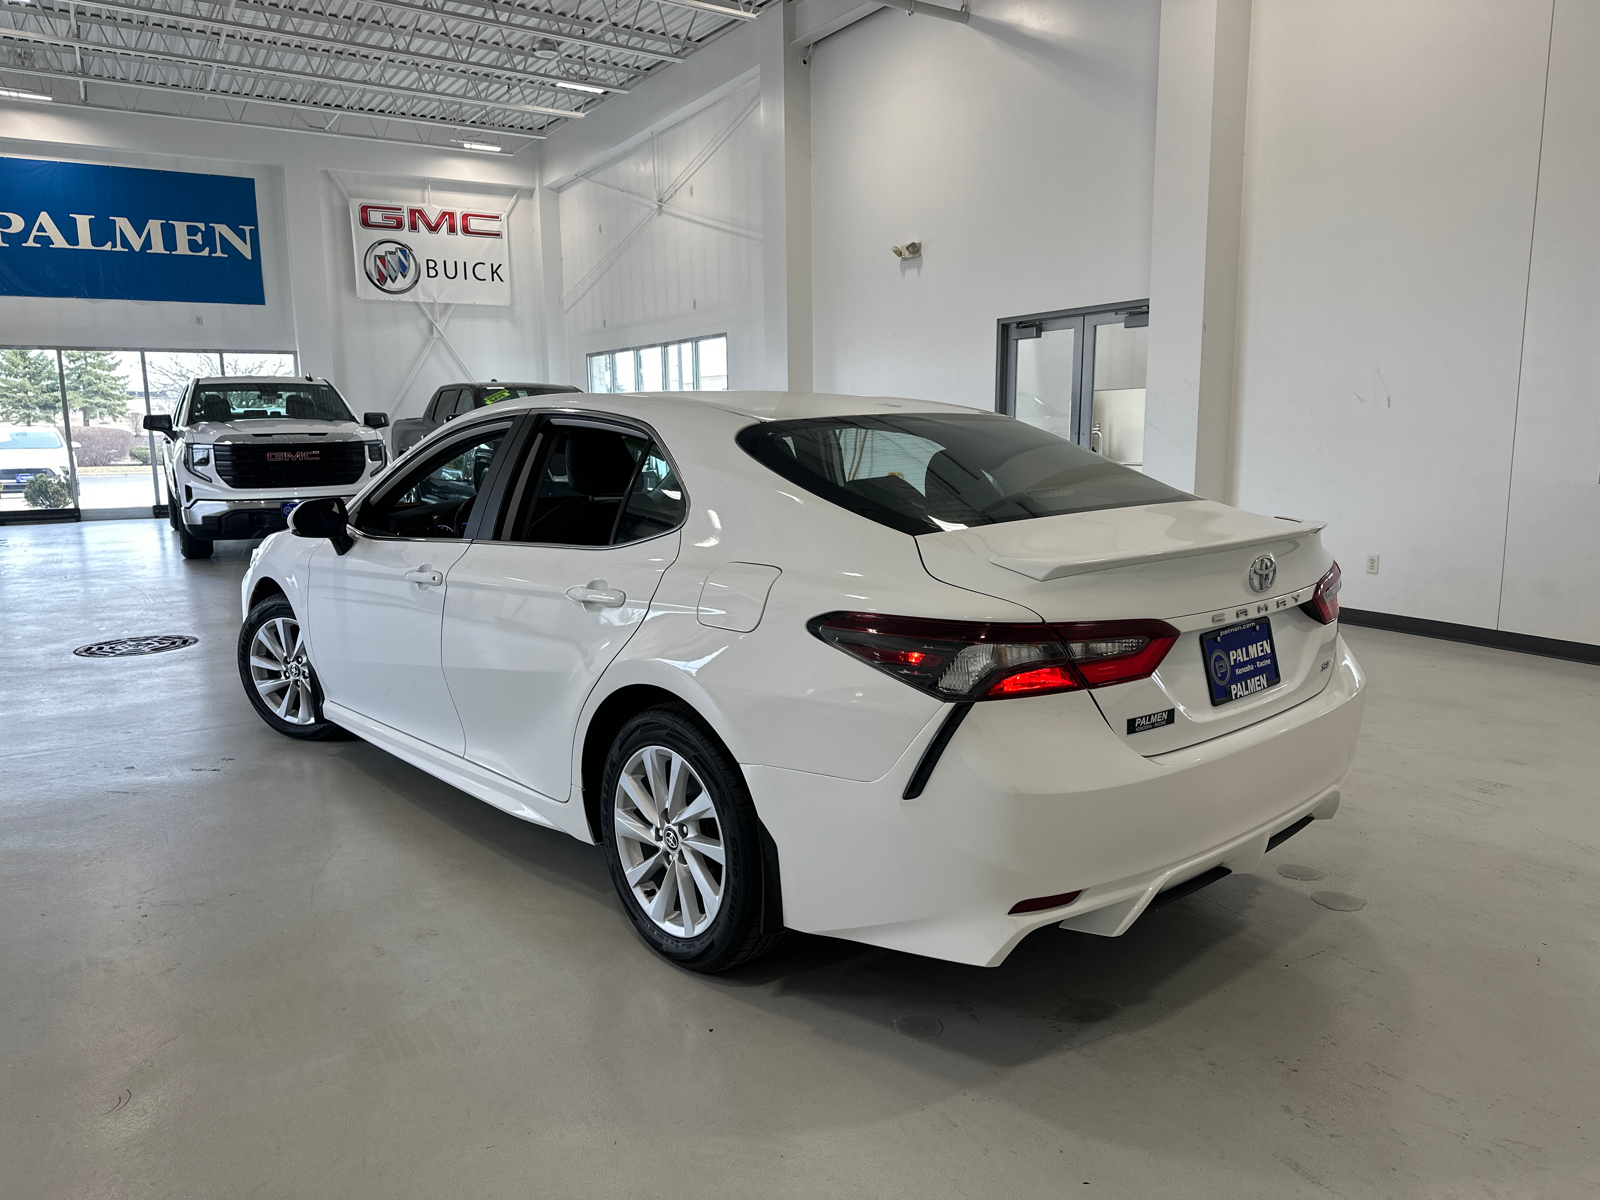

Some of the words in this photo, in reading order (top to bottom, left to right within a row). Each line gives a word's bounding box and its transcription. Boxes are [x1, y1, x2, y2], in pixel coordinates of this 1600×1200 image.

[358, 202, 503, 239] GMC
[425, 258, 504, 283] BUICK
[267, 450, 320, 462] GMC
[1211, 594, 1301, 624] CAMRY
[1219, 621, 1256, 637] palmen.com
[1229, 638, 1271, 666] PALMEN
[1235, 663, 1254, 676] Kenosha
[1256, 658, 1271, 669] Racine
[1230, 673, 1268, 700] PALMEN
[1135, 710, 1168, 728] PALMEN
